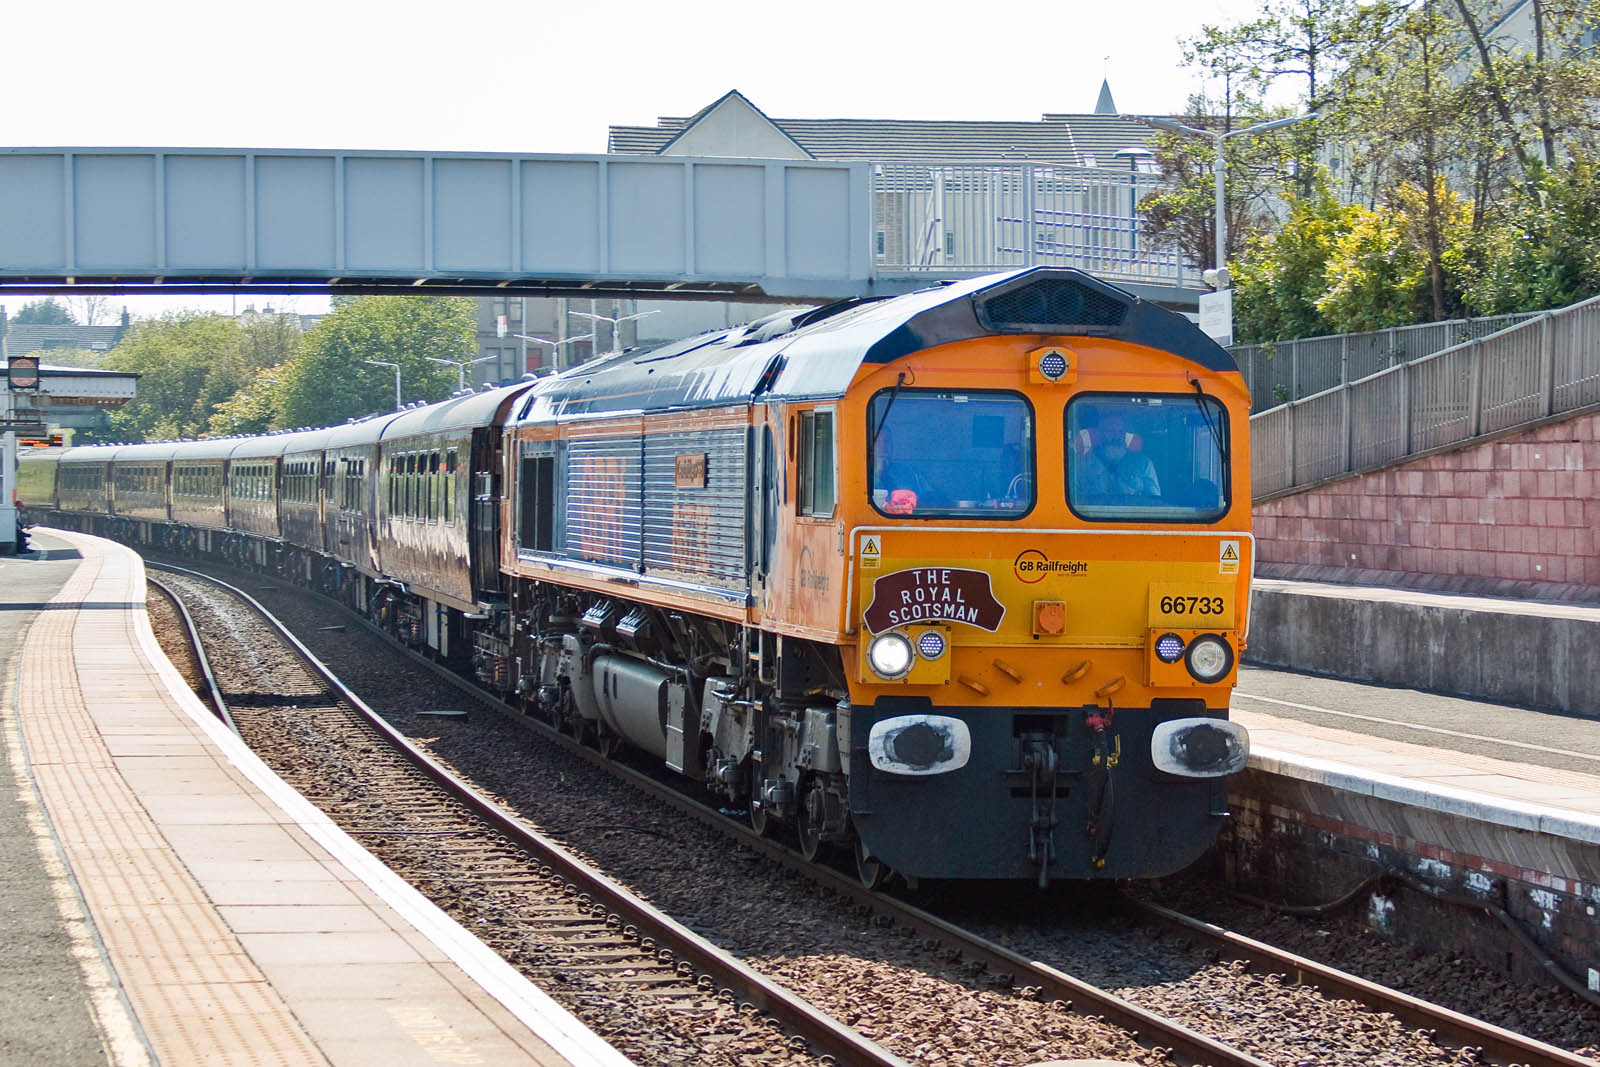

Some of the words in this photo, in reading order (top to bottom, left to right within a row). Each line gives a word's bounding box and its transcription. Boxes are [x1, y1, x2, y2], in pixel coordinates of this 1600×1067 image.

[1020, 561, 1034, 571] GB
[1036, 561, 1088, 574] Railfreight
[912, 570, 951, 585] THE
[901, 587, 965, 604] ROYAL
[888, 603, 978, 623] SCOTSMAN
[1160, 596, 1224, 615] 66733
